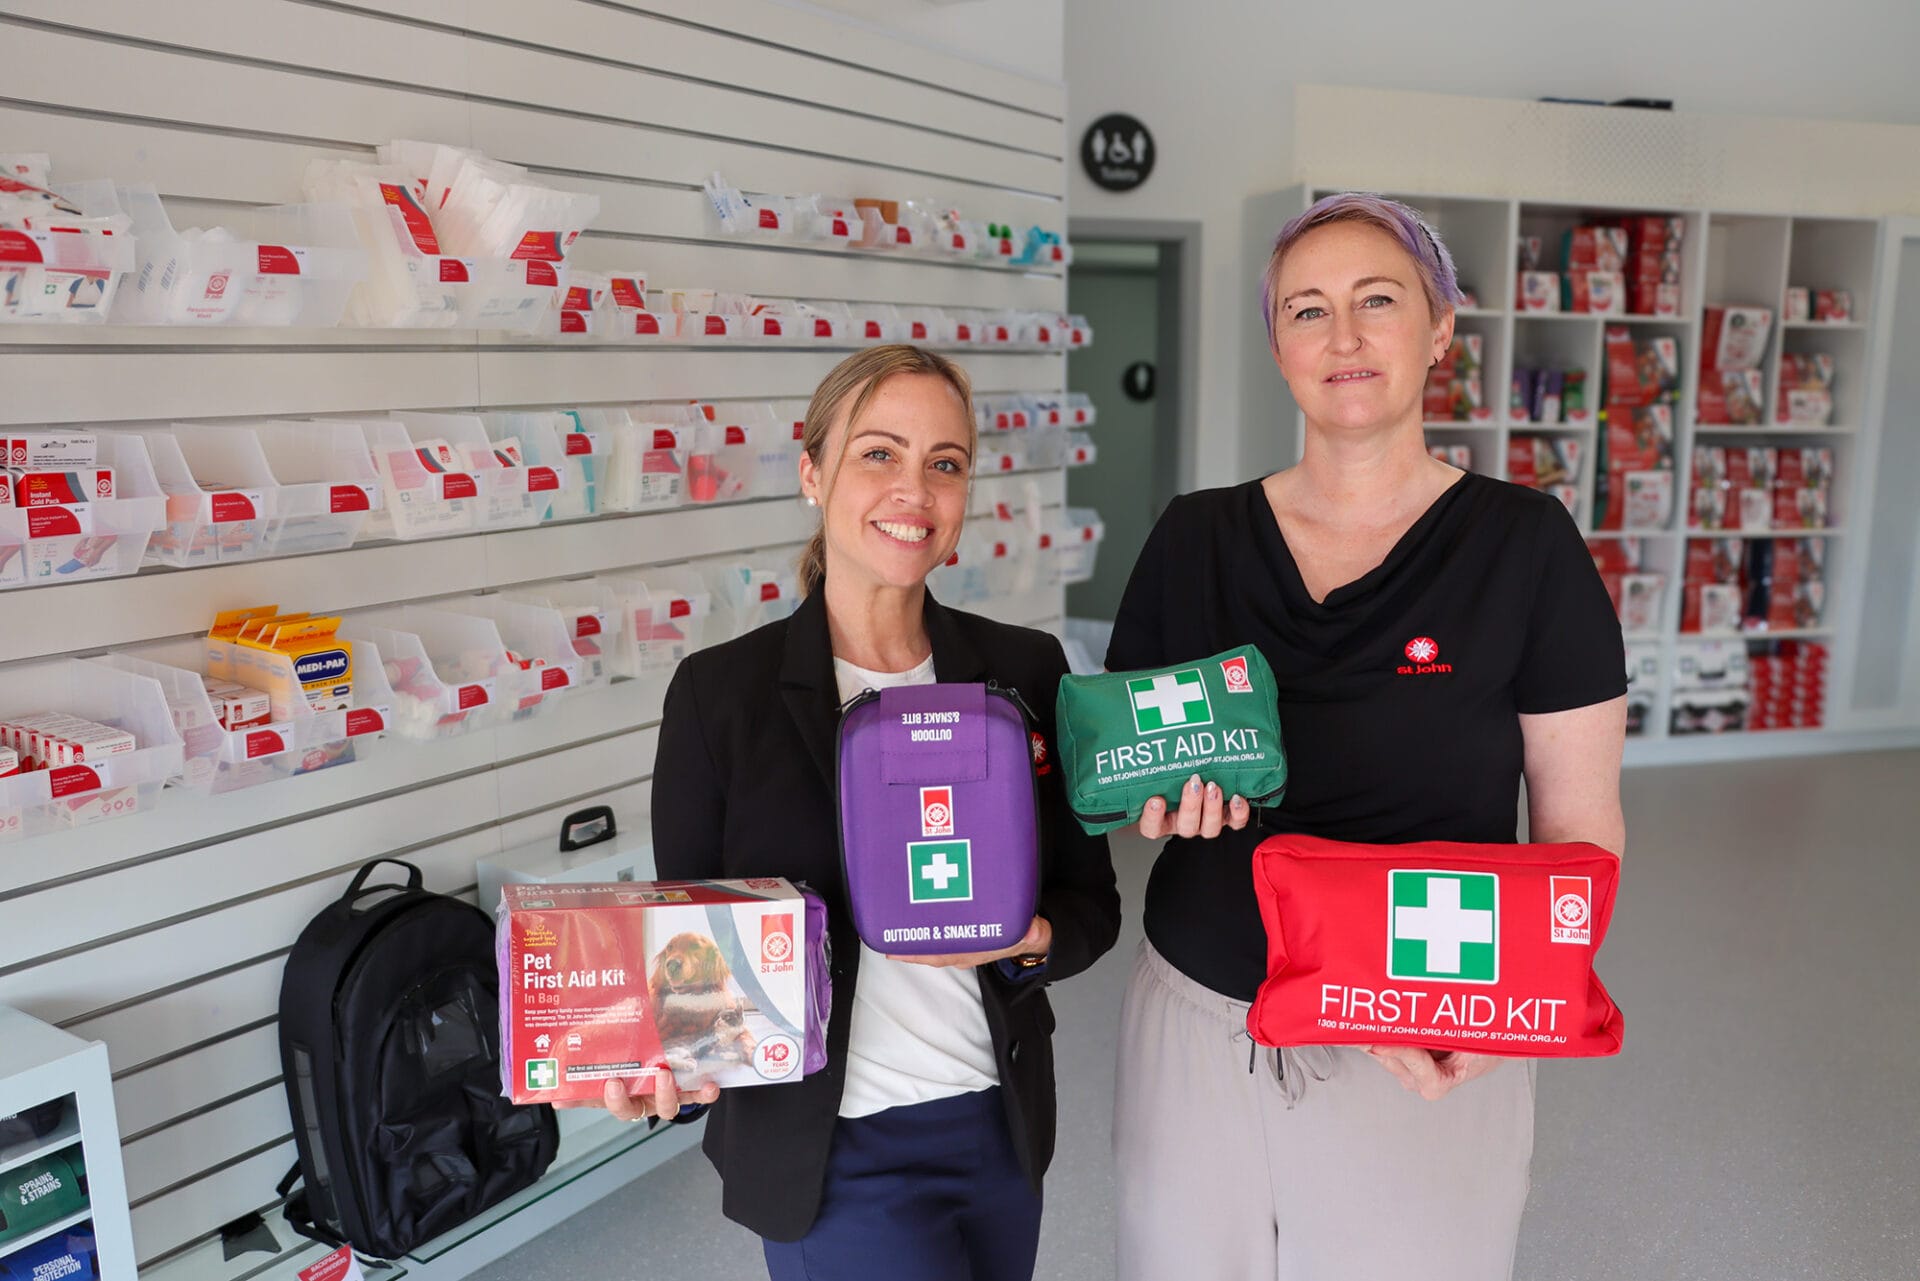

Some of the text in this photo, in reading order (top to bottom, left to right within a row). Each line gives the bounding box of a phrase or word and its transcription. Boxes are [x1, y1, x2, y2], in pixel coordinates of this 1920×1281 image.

[297, 658, 345, 674] MEDI-PAK
[1416, 663, 1452, 674] John
[902, 711, 960, 724] &SNAKE BITE
[911, 729, 952, 741] OUTDOOR
[1095, 728, 1259, 774] FIRST AID KIT
[1098, 775, 1113, 785] 1300
[884, 923, 1002, 942] OUTDOOR & SNAKE BITE
[1554, 929, 1589, 939] St John
[524, 953, 552, 970] Pet
[761, 962, 793, 973] St John
[524, 969, 625, 989] First Aid Kit
[524, 993, 560, 1006] In Bag
[1321, 983, 1567, 1031] FIRST AID KIT
[1317, 1019, 1337, 1029] 1300
[19, 1172, 54, 1195] SPRAINS
[20, 1178, 62, 1206] & STRAINS
[33, 1254, 76, 1276] PERSONAL
[33, 1260, 81, 1281] PROTECTION
[309, 1256, 347, 1281] WITH DIVIDERS
[311, 1253, 340, 1272] BACKPACK
